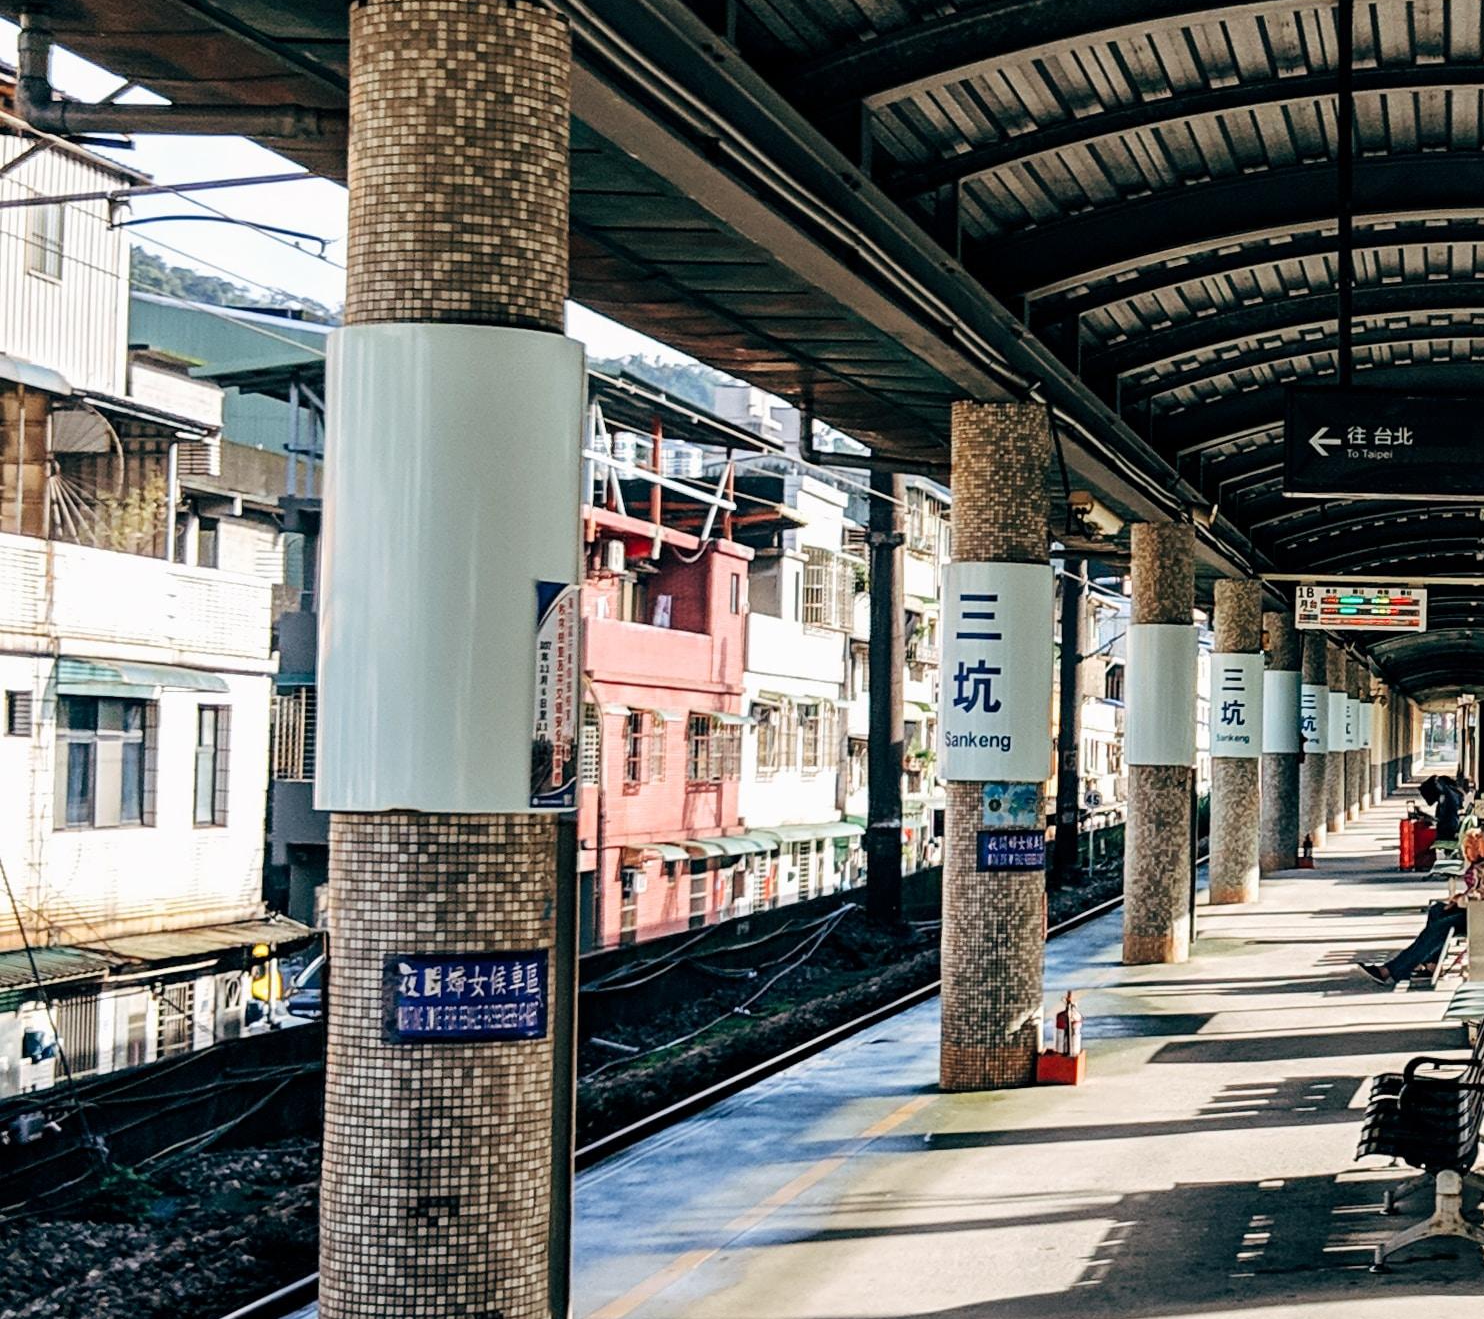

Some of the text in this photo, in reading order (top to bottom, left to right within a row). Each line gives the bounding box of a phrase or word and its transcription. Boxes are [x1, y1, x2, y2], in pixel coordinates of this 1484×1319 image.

[1347, 426, 1413, 445] 往 台北
[1347, 449, 1393, 460] To Taipei
[1298, 587, 1315, 599] 1B
[953, 594, 1002, 713] 三坑
[1221, 669, 1245, 725] 三坑
[945, 731, 1011, 752] Sankeng
[1216, 734, 1250, 744] Sankeng
